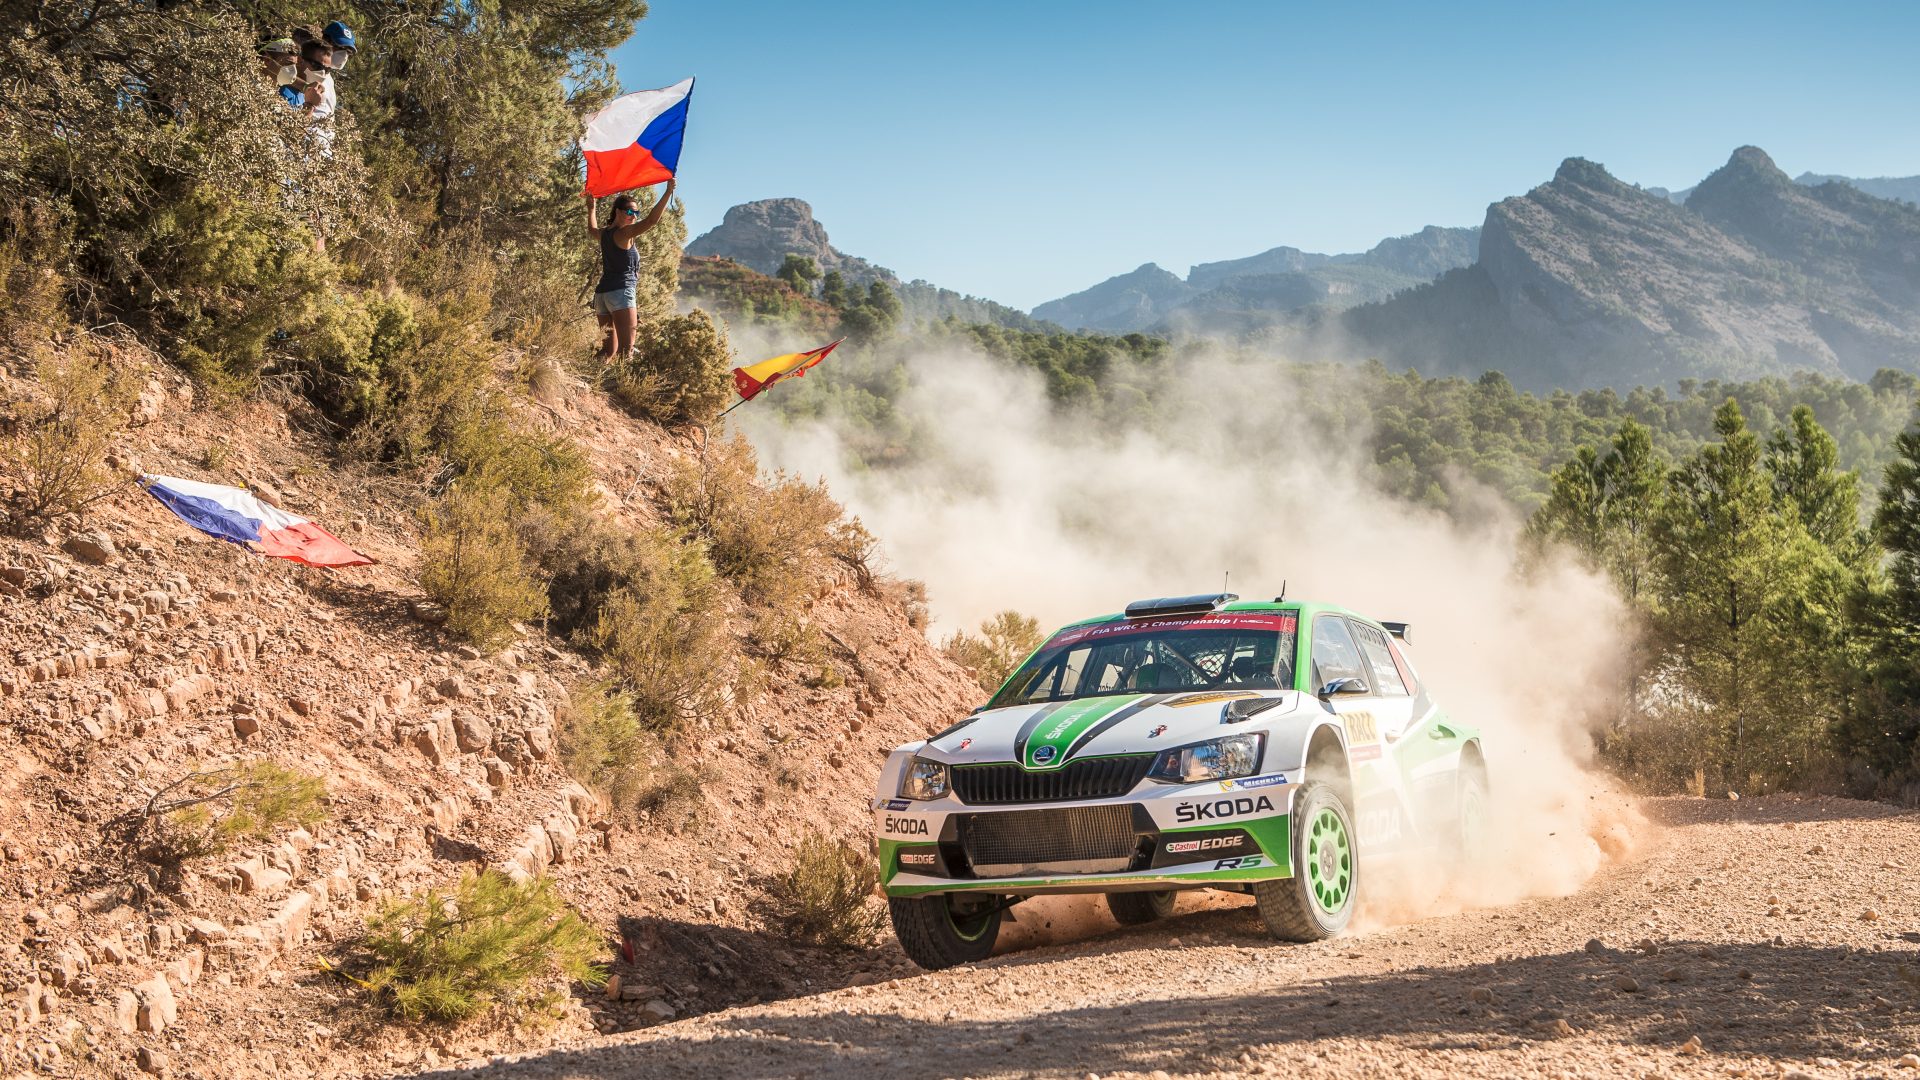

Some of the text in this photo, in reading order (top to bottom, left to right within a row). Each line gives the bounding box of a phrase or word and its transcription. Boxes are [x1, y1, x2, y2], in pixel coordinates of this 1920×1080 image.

[1091, 627, 1110, 636] FIA
[1113, 624, 1139, 632] WRC
[1151, 618, 1231, 628] Championship
[1243, 776, 1285, 787] MICHELIN
[1175, 795, 1275, 823] ŠKODA
[885, 814, 929, 835] ŠKODA
[1174, 835, 1244, 850] Castrol EDGE
[913, 854, 936, 865] EDGE
[1214, 855, 1264, 870] R5
